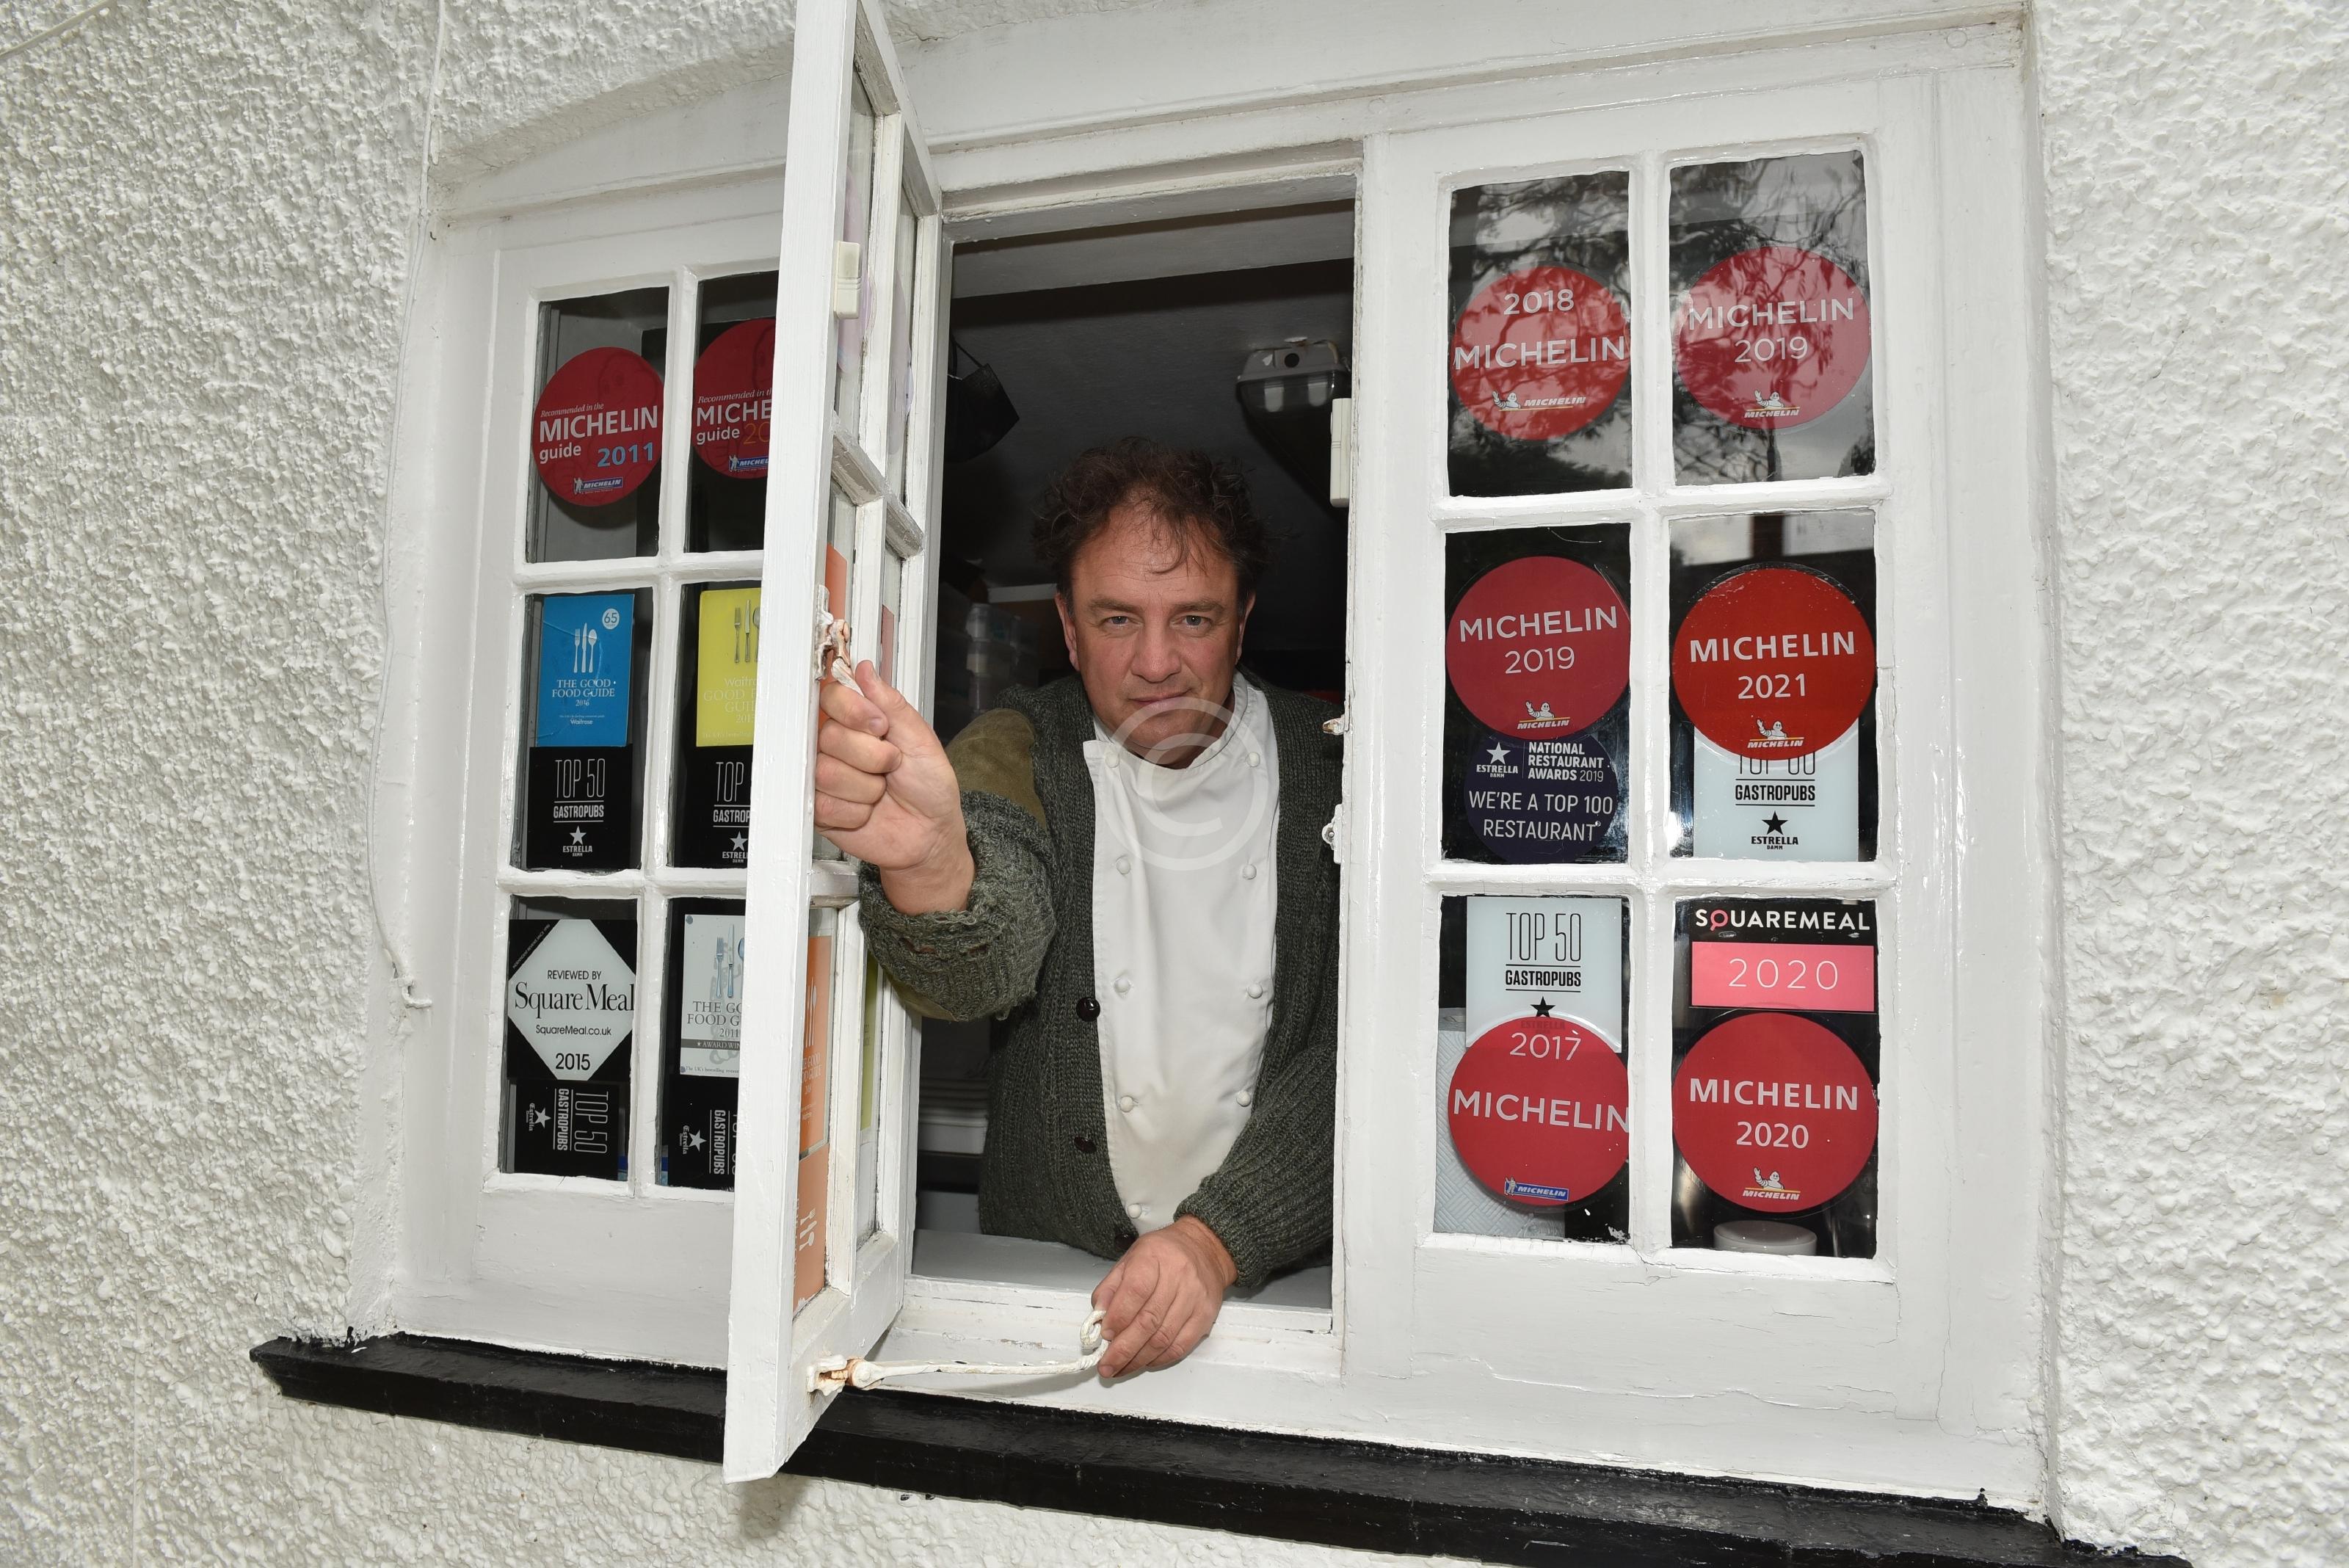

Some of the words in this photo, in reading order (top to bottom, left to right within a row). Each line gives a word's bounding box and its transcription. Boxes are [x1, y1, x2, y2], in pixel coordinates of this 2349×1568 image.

[1504, 289, 1574, 314] 2018
[1689, 298, 1854, 330] MICHELIN
[1454, 336, 1624, 369] MICHELIN
[1735, 336, 1808, 362] 2019
[698, 390, 755, 404] Recommended
[1525, 397, 1586, 406] MICHELIN
[540, 404, 587, 417] Recommended
[1744, 410, 1799, 418] MICHELIN
[540, 405, 658, 443] MICHELIN
[697, 427, 740, 445] guide
[540, 442, 581, 464] guide
[598, 442, 653, 467] 2011
[584, 479, 621, 489] MICHELIN
[603, 612, 618, 624] 65
[1460, 606, 1617, 642] MICHELIN
[1690, 631, 1855, 662] MICHELIN
[1505, 646, 1575, 674] 2019
[556, 680, 577, 688] THE
[580, 679, 611, 688] GOOD
[1738, 673, 1805, 699] 2021
[552, 689, 581, 697] FOOD
[583, 689, 615, 697] GUIDE
[704, 690, 745, 701] GOOD
[1517, 719, 1570, 729] MICHELIN
[1528, 741, 1584, 755] NATIONAL
[1747, 740, 1804, 748] MICHELIN
[1476, 765, 1518, 774] ESTRELLA
[1528, 755, 1604, 768] RESTAURANT
[555, 759, 581, 798] TOP
[587, 758, 605, 798] 50
[716, 762, 744, 802] TOP
[1528, 768, 1577, 780] AWARDS
[1580, 771, 1603, 783] 2019
[1735, 785, 1815, 800] GASTROPUBS
[1469, 791, 1522, 810] WE'RE
[1527, 794, 1539, 811] A
[1544, 794, 1578, 812] TOP
[1584, 796, 1613, 814] 100
[553, 805, 604, 819] GASTROPUBS
[1484, 819, 1596, 841] RESTAURANT
[1751, 836, 1798, 845] ESTRELLA
[1696, 909, 1870, 931] SQUAREMEAL
[1506, 913, 1544, 961] TOP
[1555, 913, 1581, 962] 50
[548, 970, 589, 979] REVIEWED
[592, 970, 602, 980] BY
[1506, 970, 1581, 987] GASTROPUBS
[1729, 958, 1838, 990] 2020
[693, 1001, 721, 1012] THE
[687, 1014, 726, 1025] FOOD
[536, 1025, 611, 1036] SquareMeal.co.uk
[1510, 1032, 1581, 1060] 2017
[556, 1053, 590, 1070] 2015
[1690, 1078, 1857, 1110] MICHELIN
[576, 1091, 609, 1124] TOP
[1453, 1089, 1630, 1133] MICHELIN
[557, 1089, 570, 1151] GASTROPUBS
[574, 1130, 608, 1153] 50
[714, 1110, 726, 1175] GASTROPUBS
[1737, 1122, 1809, 1148] 2020
[1518, 1186, 1566, 1197] MICHELIN
[1743, 1190, 1800, 1200] MICHELIN
